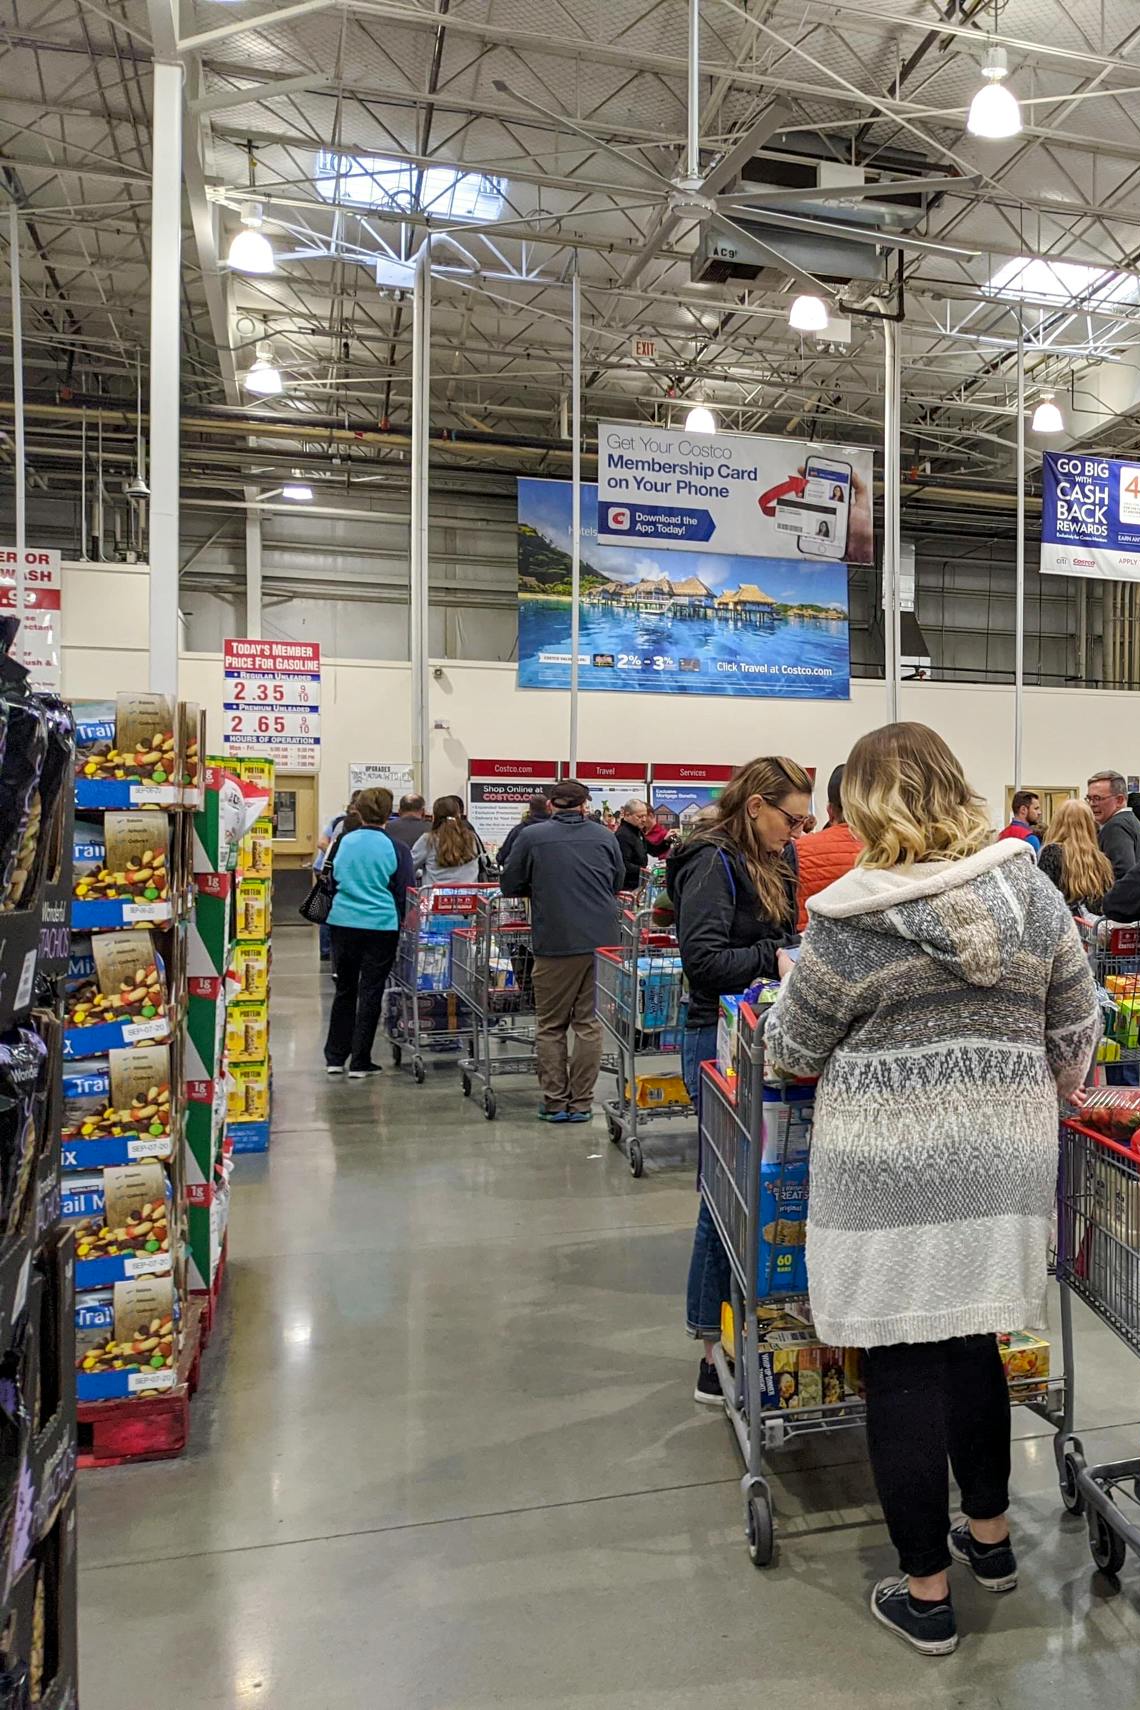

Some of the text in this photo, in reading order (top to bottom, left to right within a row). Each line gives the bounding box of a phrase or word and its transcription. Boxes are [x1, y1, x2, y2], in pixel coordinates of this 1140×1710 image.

[636, 341, 656, 357] EXIT
[606, 433, 732, 459] Get Your Costco
[607, 453, 758, 481] Membership Card
[1057, 459, 1109, 478] GO BIG
[607, 475, 729, 498] on Your Phone
[1075, 475, 1092, 484] WITH
[1056, 482, 1109, 505] CASH
[635, 512, 698, 526] Download the
[1056, 500, 1108, 524] BACK
[568, 525, 598, 537] tels
[635, 522, 686, 536] App Today!
[1056, 520, 1108, 536] REWARDS
[231, 642, 313, 657] TODAY'S MEMBER
[225, 656, 319, 671] PRICE FOR GASOLINE
[716, 661, 833, 677] Click Travel at Costco.com
[240, 671, 312, 681] REGULAR UNLEADED
[239, 704, 310, 713] PREMIUM UNLEADED
[77, 723, 116, 739] Trail
[272, 736, 314, 744] OPERATION
[494, 764, 533, 774] Costco.com
[596, 766, 616, 776] Travel
[679, 768, 706, 777] Services
[483, 785, 543, 795] Shop Online at
[11, 1066, 39, 1083] Wonde
[72, 1076, 109, 1093] Trai
[777, 1254, 792, 1266] 60
